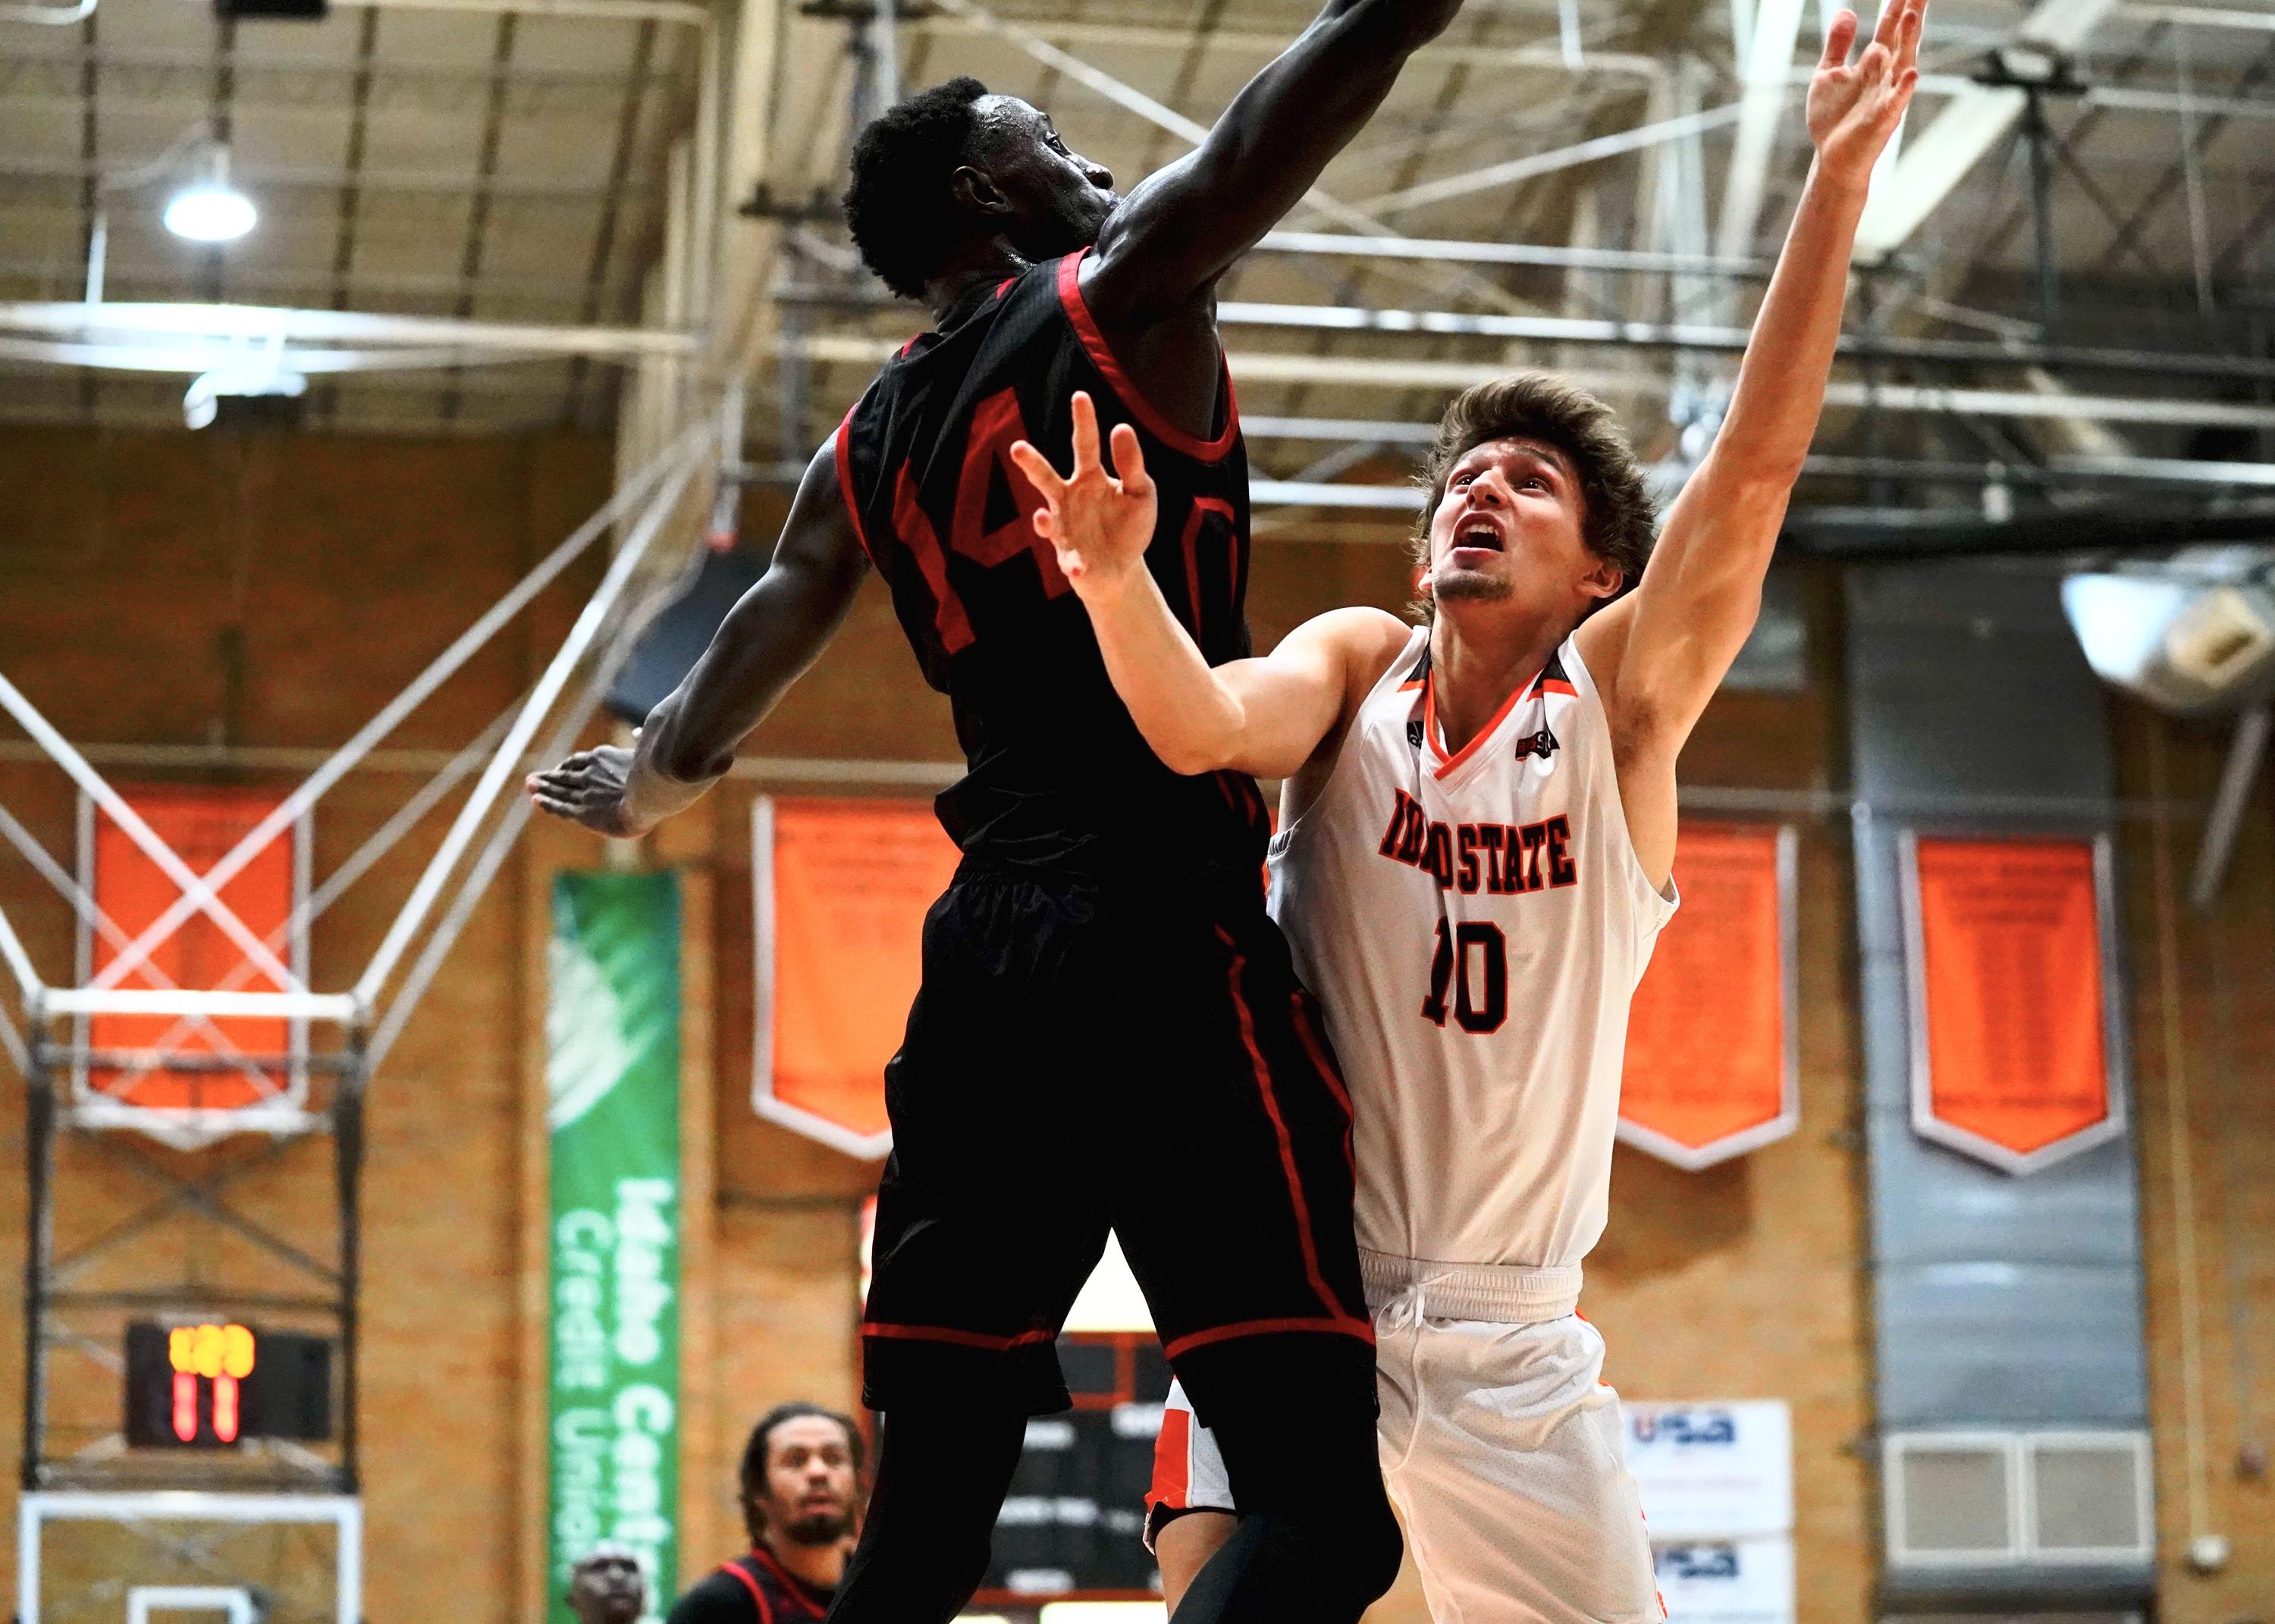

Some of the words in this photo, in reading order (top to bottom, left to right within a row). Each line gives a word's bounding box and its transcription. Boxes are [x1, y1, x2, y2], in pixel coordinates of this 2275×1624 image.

[892, 386, 1074, 655] 14
[1456, 813, 1577, 895] STATE
[1421, 915, 1508, 1034] 10
